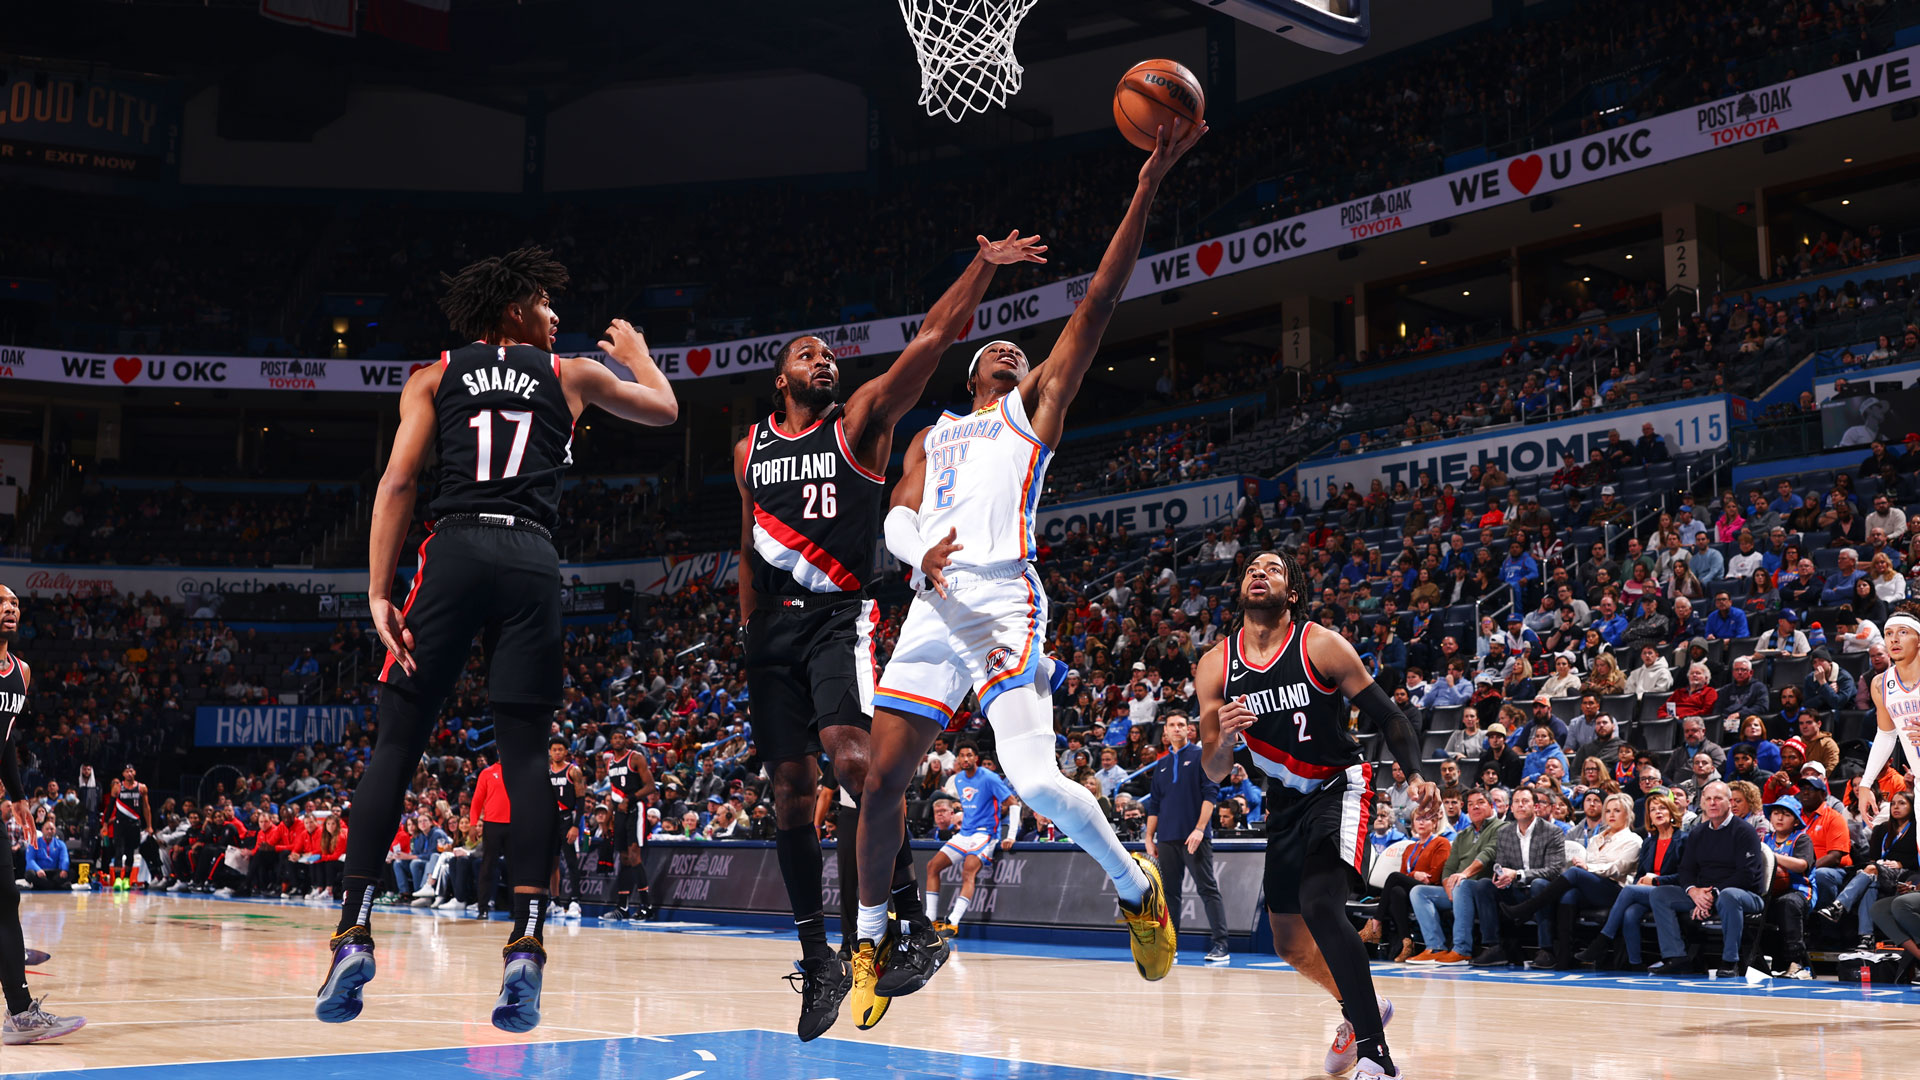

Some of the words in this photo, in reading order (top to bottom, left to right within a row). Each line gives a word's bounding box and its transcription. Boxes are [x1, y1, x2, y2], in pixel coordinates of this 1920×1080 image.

[1842, 57, 1911, 103] WE
[87, 85, 158, 145] CITY
[1697, 100, 1735, 131] POST
[1759, 86, 1792, 115] OAK
[1711, 117, 1779, 146] TOYOTA
[45, 149, 88, 165] EXIT
[93, 156, 137, 171] NOW
[1449, 169, 1500, 207] WE
[1550, 149, 1572, 180] U
[1581, 128, 1653, 171] OKC
[1341, 203, 1370, 226] POST
[1387, 189, 1412, 214] OAK
[1350, 216, 1403, 240] TOYOTA
[1151, 252, 1191, 285] WE
[1229, 237, 1246, 264] U
[1252, 222, 1308, 258] OKC
[1066, 278, 1089, 299] POST
[849, 325, 870, 342] OAK
[901, 319, 925, 343] W
[978, 307, 992, 330] U
[998, 295, 1039, 325] OKC
[716, 347, 730, 368] U
[834, 344, 861, 357] YOTA
[62, 356, 106, 379] WE
[148, 361, 165, 380] U
[173, 362, 227, 381] OKC
[260, 361, 287, 376] POST
[304, 363, 326, 377] OAK
[360, 365, 402, 386] WE
[269, 378, 316, 388] TOYOTA
[462, 366, 540, 400] SHARPE
[468, 408, 534, 483] 17
[928, 419, 1004, 452] LAHOMA
[933, 441, 970, 472] CITY
[1382, 452, 1468, 491] THE
[1478, 429, 1617, 474] HOME
[1675, 414, 1722, 446] 115
[751, 452, 837, 489] PORTLAND
[802, 482, 838, 520] 26
[934, 466, 957, 511] 2
[1044, 506, 1136, 543] COME
[1142, 498, 1187, 528] TO
[1202, 492, 1234, 518] 114
[26, 571, 75, 594] Bally
[783, 598, 805, 608] ripcity
[1232, 659, 1239, 670] 6
[1293, 711, 1312, 743] 2
[668, 854, 695, 876] POST
[708, 855, 733, 877] OAK
[993, 859, 1027, 884] OAK
[673, 880, 711, 900] ACURA
[947, 887, 998, 913] AURA
